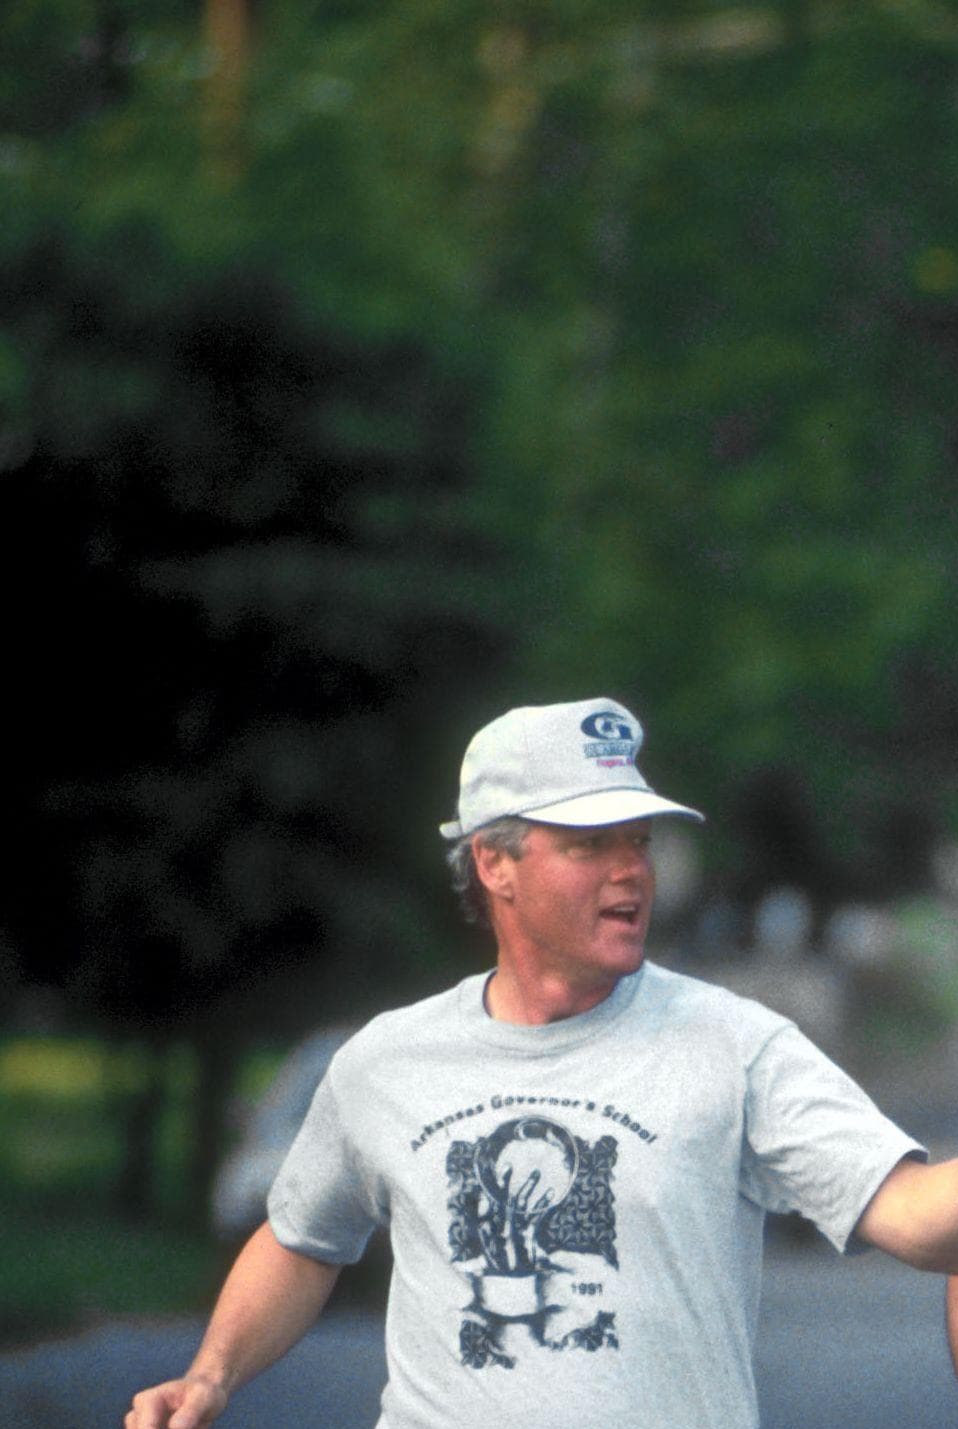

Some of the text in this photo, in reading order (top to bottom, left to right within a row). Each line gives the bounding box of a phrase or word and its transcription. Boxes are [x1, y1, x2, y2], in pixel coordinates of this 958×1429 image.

[411, 1094, 659, 1151] Arkansas Governor's School
[571, 1282, 603, 1295] 1991
